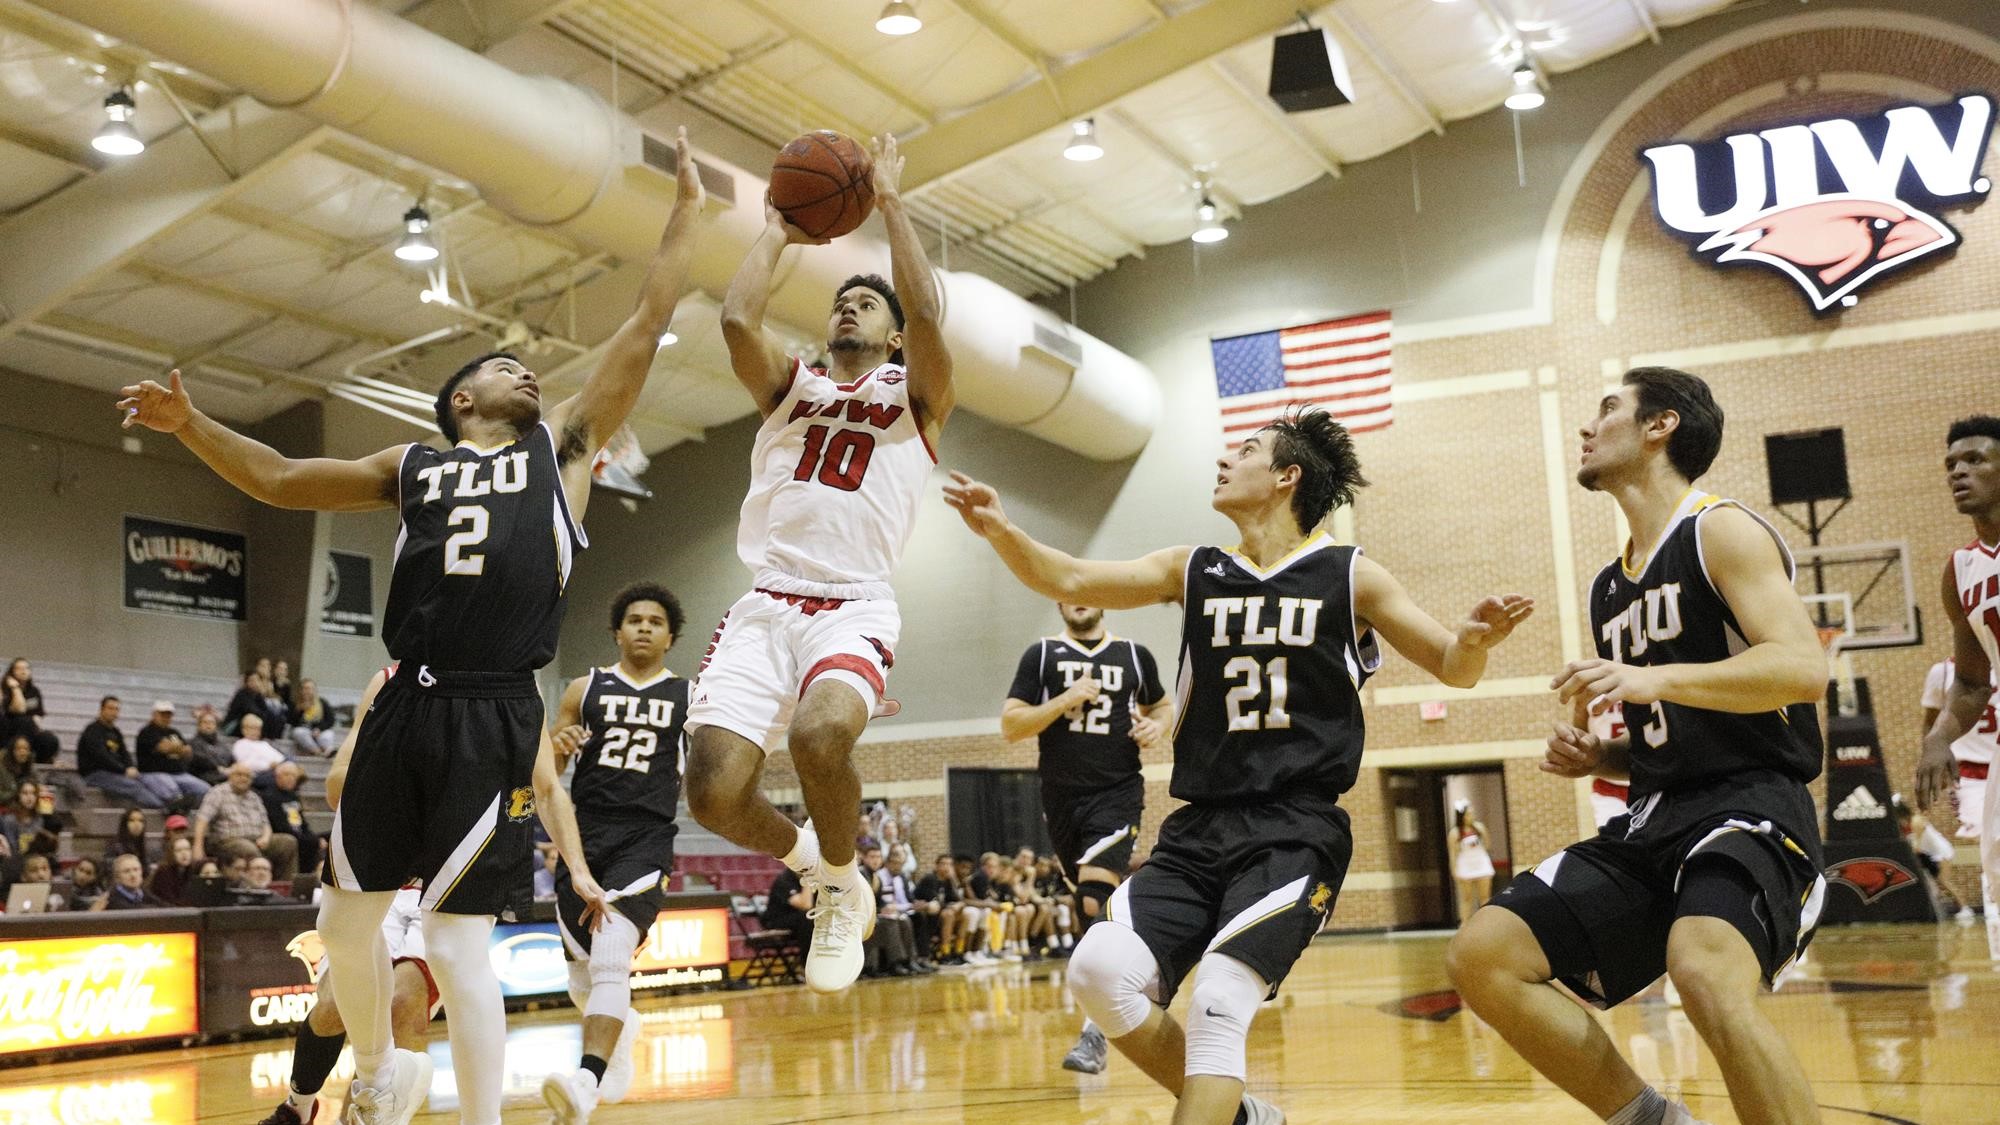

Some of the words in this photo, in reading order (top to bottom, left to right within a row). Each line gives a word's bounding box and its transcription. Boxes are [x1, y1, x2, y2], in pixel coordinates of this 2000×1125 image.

[1644, 95, 1991, 233] UIW
[789, 398, 904, 430] UIW
[417, 450, 529, 504] TLU
[793, 424, 875, 492] 10
[127, 530, 243, 577] GUILLERMO'S
[444, 504, 489, 576] 2
[1203, 596, 1323, 648] TLU
[1602, 581, 1682, 664] TLU
[1057, 660, 1123, 692] TLU
[1224, 656, 1290, 732] 21
[599, 694, 675, 729] TLU
[598, 726, 657, 774] 22
